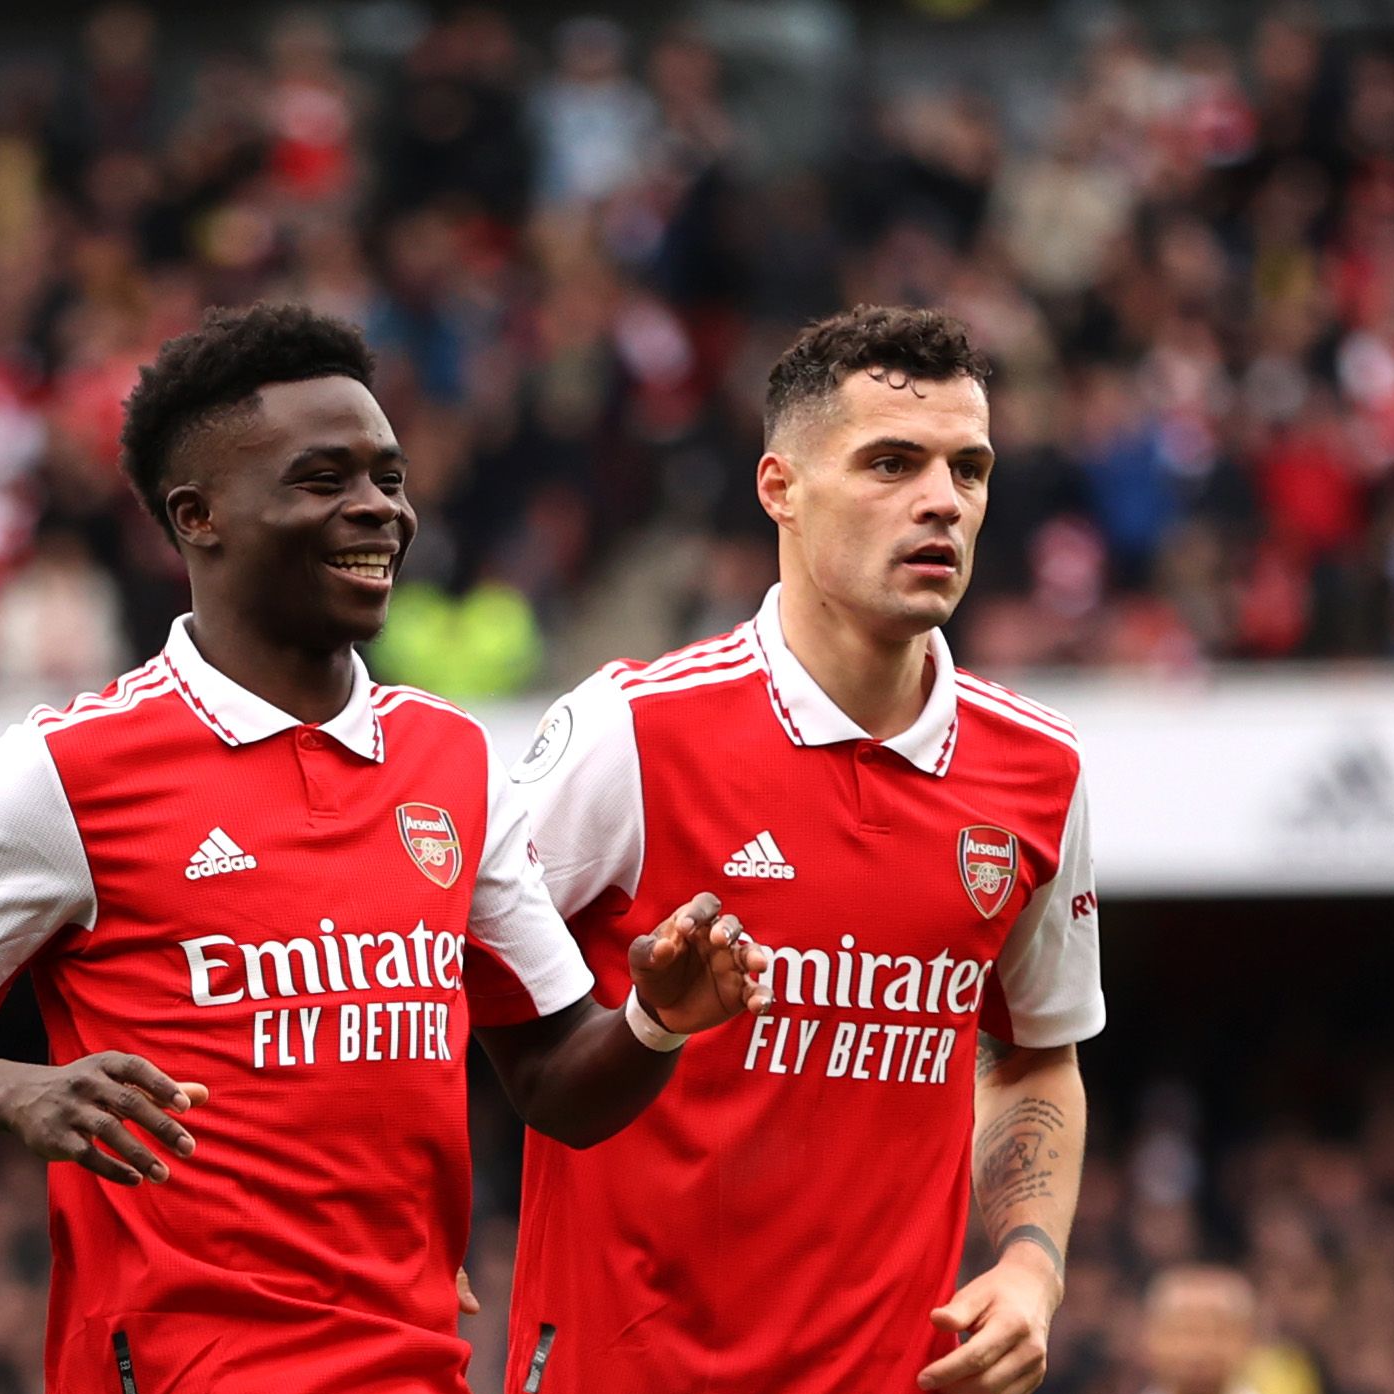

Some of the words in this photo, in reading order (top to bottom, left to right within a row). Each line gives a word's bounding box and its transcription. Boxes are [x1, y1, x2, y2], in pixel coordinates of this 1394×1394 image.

[406, 816, 447, 832] Arsenal
[185, 854, 257, 881] adidas
[723, 860, 795, 880] adidas
[967, 839, 1010, 858] Arsenal
[178, 918, 466, 1007] Emirates
[738, 934, 993, 1014] mirates
[254, 1006, 322, 1068] FLY
[339, 1001, 452, 1062] BETTER
[744, 1015, 820, 1076] FLY
[826, 1021, 955, 1084] BETTER
